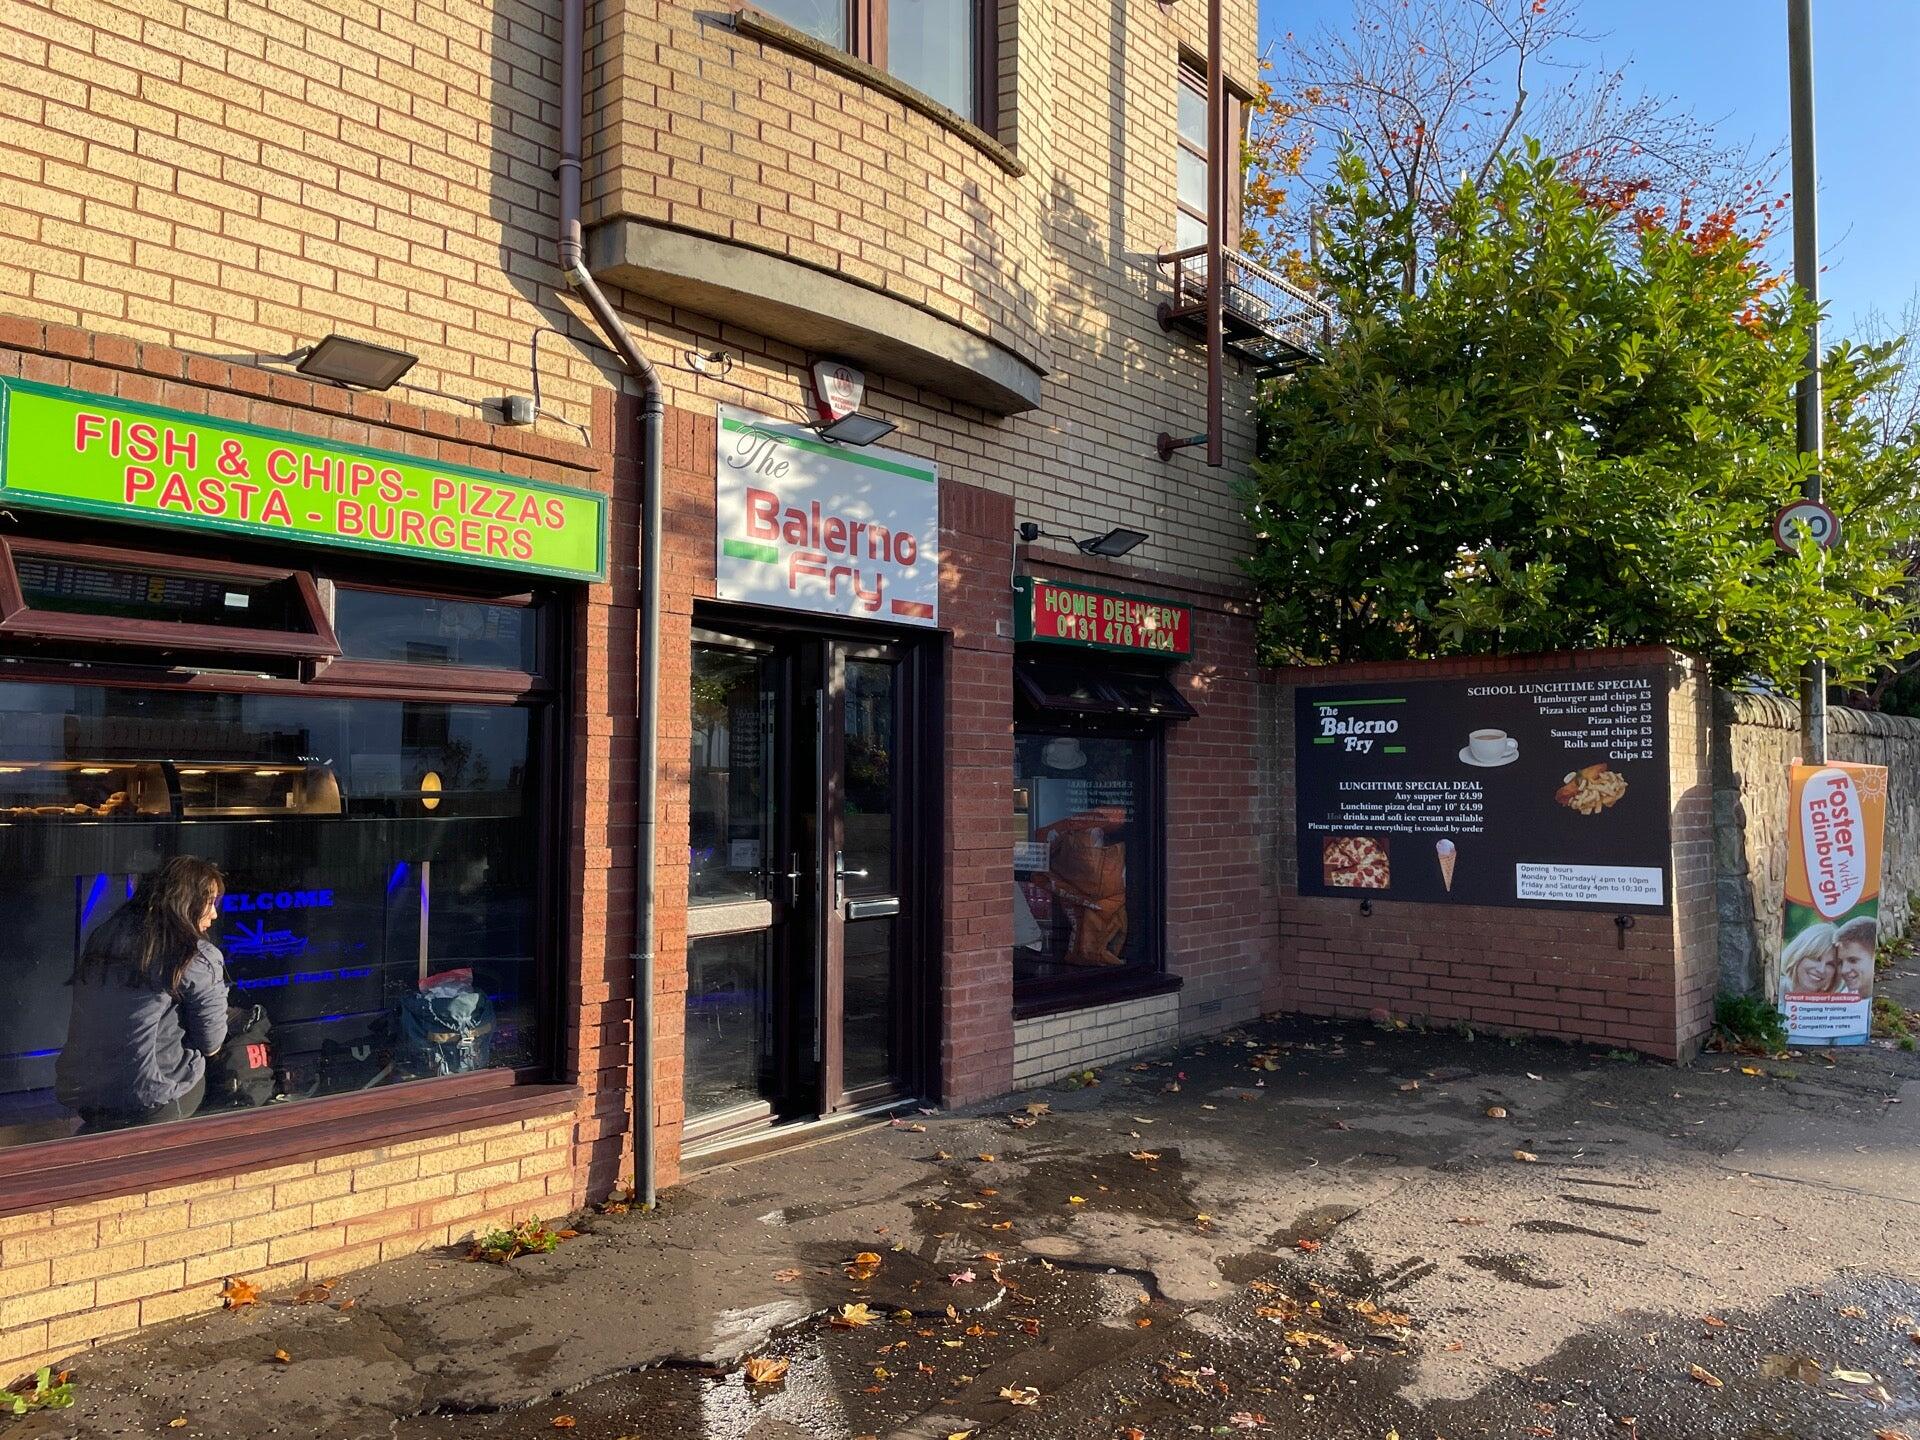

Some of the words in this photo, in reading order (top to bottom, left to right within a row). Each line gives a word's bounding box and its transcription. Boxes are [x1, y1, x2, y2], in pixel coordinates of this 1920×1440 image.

[727, 425, 790, 479] The
[75, 412, 198, 470] FISH
[217, 440, 251, 478] &
[432, 477, 567, 531] PIZZAS
[124, 465, 293, 526] PASTA
[336, 500, 534, 561] BURGERS
[746, 487, 917, 566] Balerno
[788, 552, 882, 612] Fry
[1045, 588, 1098, 619] HOME
[1103, 598, 1182, 630] DELIVERY
[1056, 614, 1097, 642] 0131
[1138, 626, 1175, 652] 7204
[1467, 685, 1516, 697] SCHOOL
[1519, 681, 1595, 694] LUNCHTIME
[1597, 679, 1652, 690] SPECIAL
[1533, 694, 1588, 705] Hamburger
[1589, 692, 1608, 702] and
[1610, 691, 1637, 703] chips
[1319, 706, 1339, 717] The
[1539, 706, 1563, 715] Pizza
[1565, 705, 1588, 714] slice
[1589, 704, 1608, 713] and
[1610, 703, 1637, 715] chips
[1587, 716, 1612, 725] Pizza
[1614, 715, 1638, 724] slice
[1639, 714, 1652, 723] £2
[1320, 717, 1399, 736] Balerno
[1550, 728, 1588, 739] Sausage
[1590, 727, 1609, 736] and
[1610, 726, 1638, 738] chips
[1343, 736, 1374, 754] Fry
[1564, 740, 1589, 749] Rolls
[1590, 739, 1609, 748] and
[1611, 738, 1638, 750] chips
[1640, 738, 1653, 747] £2
[1609, 750, 1639, 762] Chips
[1640, 750, 1653, 759] £2
[1339, 781, 1403, 791] LUNCHTIME
[1405, 781, 1450, 791] SPECIAL
[1453, 781, 1483, 790] DEAL
[1394, 792, 1412, 801] Any
[1413, 793, 1443, 802] supper
[1444, 791, 1457, 800] for
[1458, 792, 1483, 800] £4.99
[1340, 802, 1383, 811] Lunchtime
[1384, 803, 1405, 812] pizza
[1406, 803, 1425, 811] deal
[1426, 804, 1442, 813] any
[1459, 803, 1483, 811] £4.99
[1343, 812, 1369, 821] drinks
[1370, 813, 1387, 821] and
[1387, 813, 1403, 822] soft
[1404, 813, 1416, 822] ice
[1445, 813, 1483, 823] available
[1826, 776, 1855, 858] Foster
[1308, 822, 1330, 830] Please
[1331, 824, 1343, 832] pre
[1344, 823, 1364, 831] order
[1374, 823, 1413, 833] everything
[1414, 824, 1421, 832] is
[1422, 824, 1449, 832] cooked
[1450, 824, 1460, 834] by
[1461, 824, 1483, 833] order
[1809, 798, 1841, 907] Edinburgh
[1520, 865, 1549, 874] Opening
[1521, 873, 1547, 882] Monday
[1628, 877, 1649, 885] 10pm
[1836, 860, 1859, 894] with
[1521, 881, 1543, 890] Friday
[1559, 883, 1591, 891] Saturday
[1593, 884, 1609, 892] 4pm
[1621, 885, 1643, 893] 10:30
[1521, 889, 1546, 897] Sunday
[1548, 890, 1564, 898] 4pm
[221, 888, 334, 912] ELCOME
